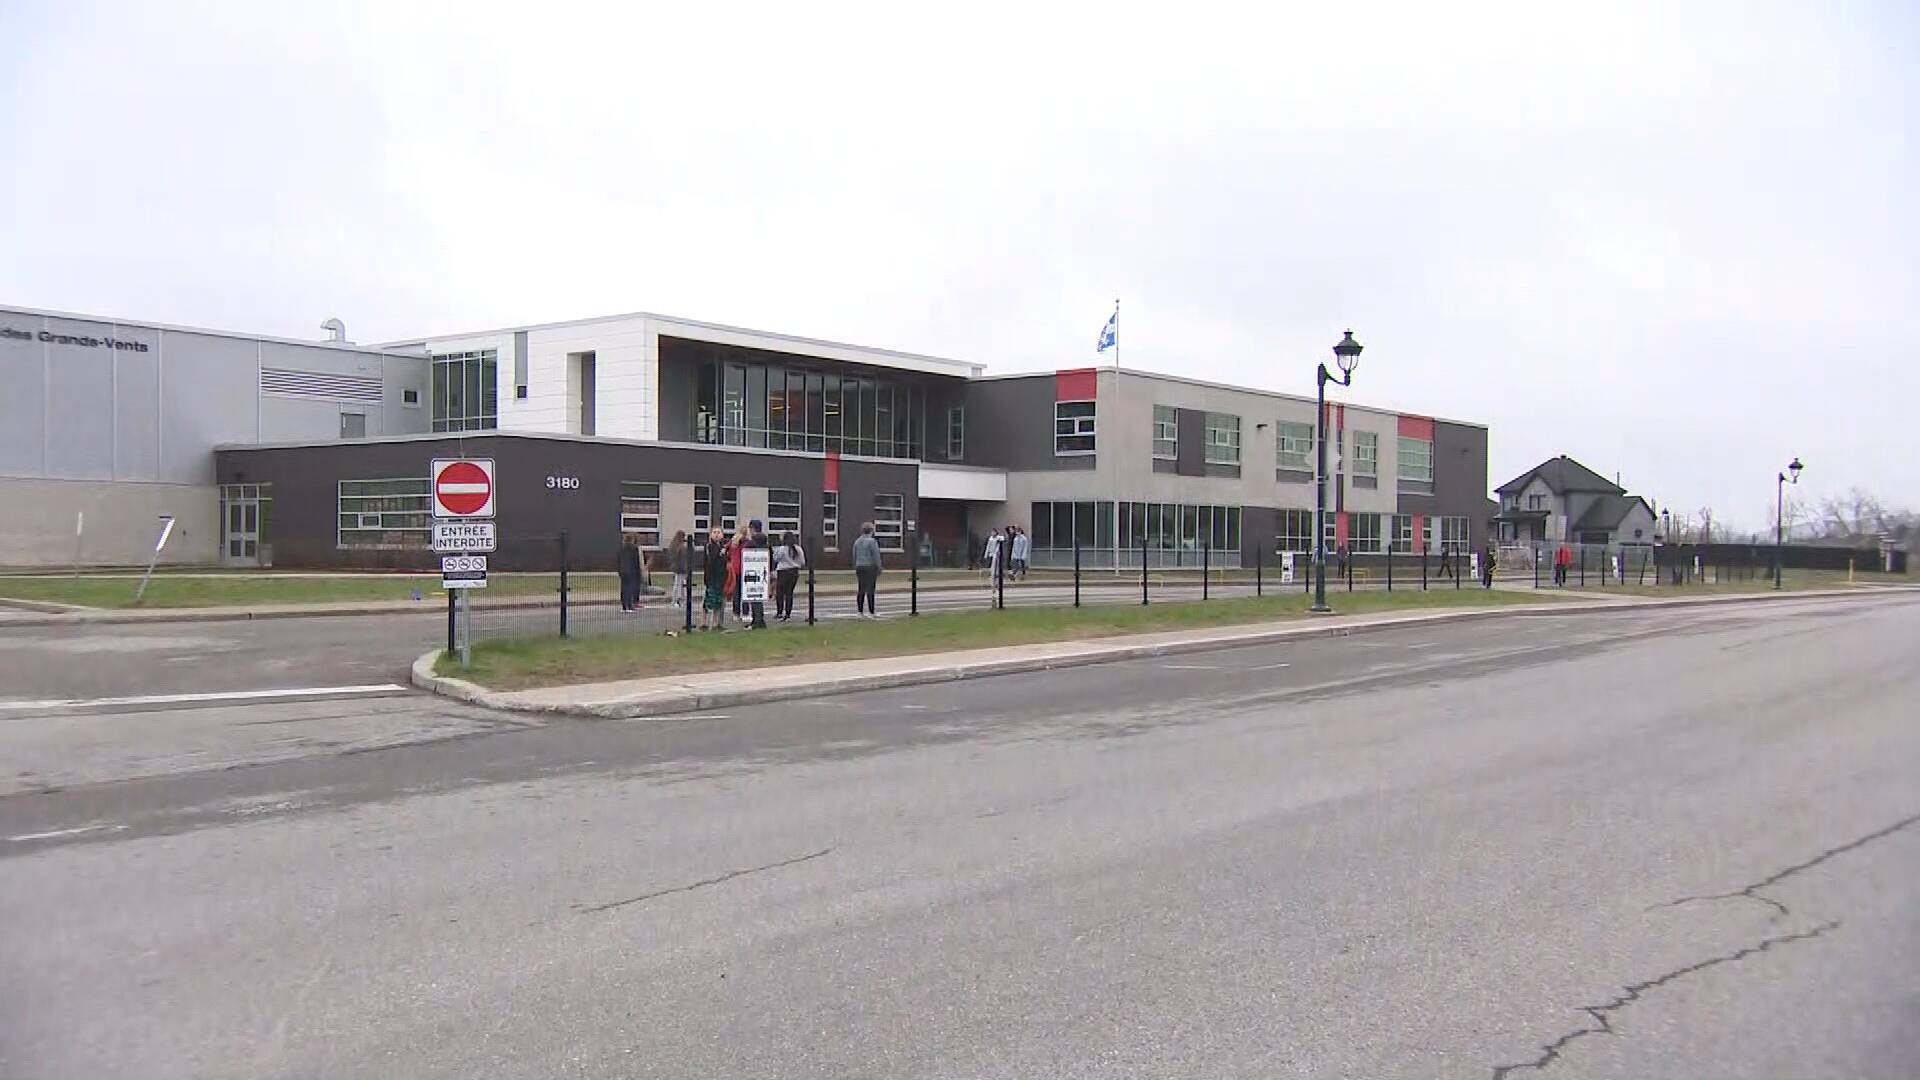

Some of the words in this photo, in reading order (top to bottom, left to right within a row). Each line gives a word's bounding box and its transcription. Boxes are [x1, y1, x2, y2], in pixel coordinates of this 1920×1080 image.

[38, 331, 149, 352] Grands-Vents
[546, 476, 580, 489] 3180
[441, 525, 487, 537] ENTRÉE
[435, 537, 493, 548] INTERDITE
